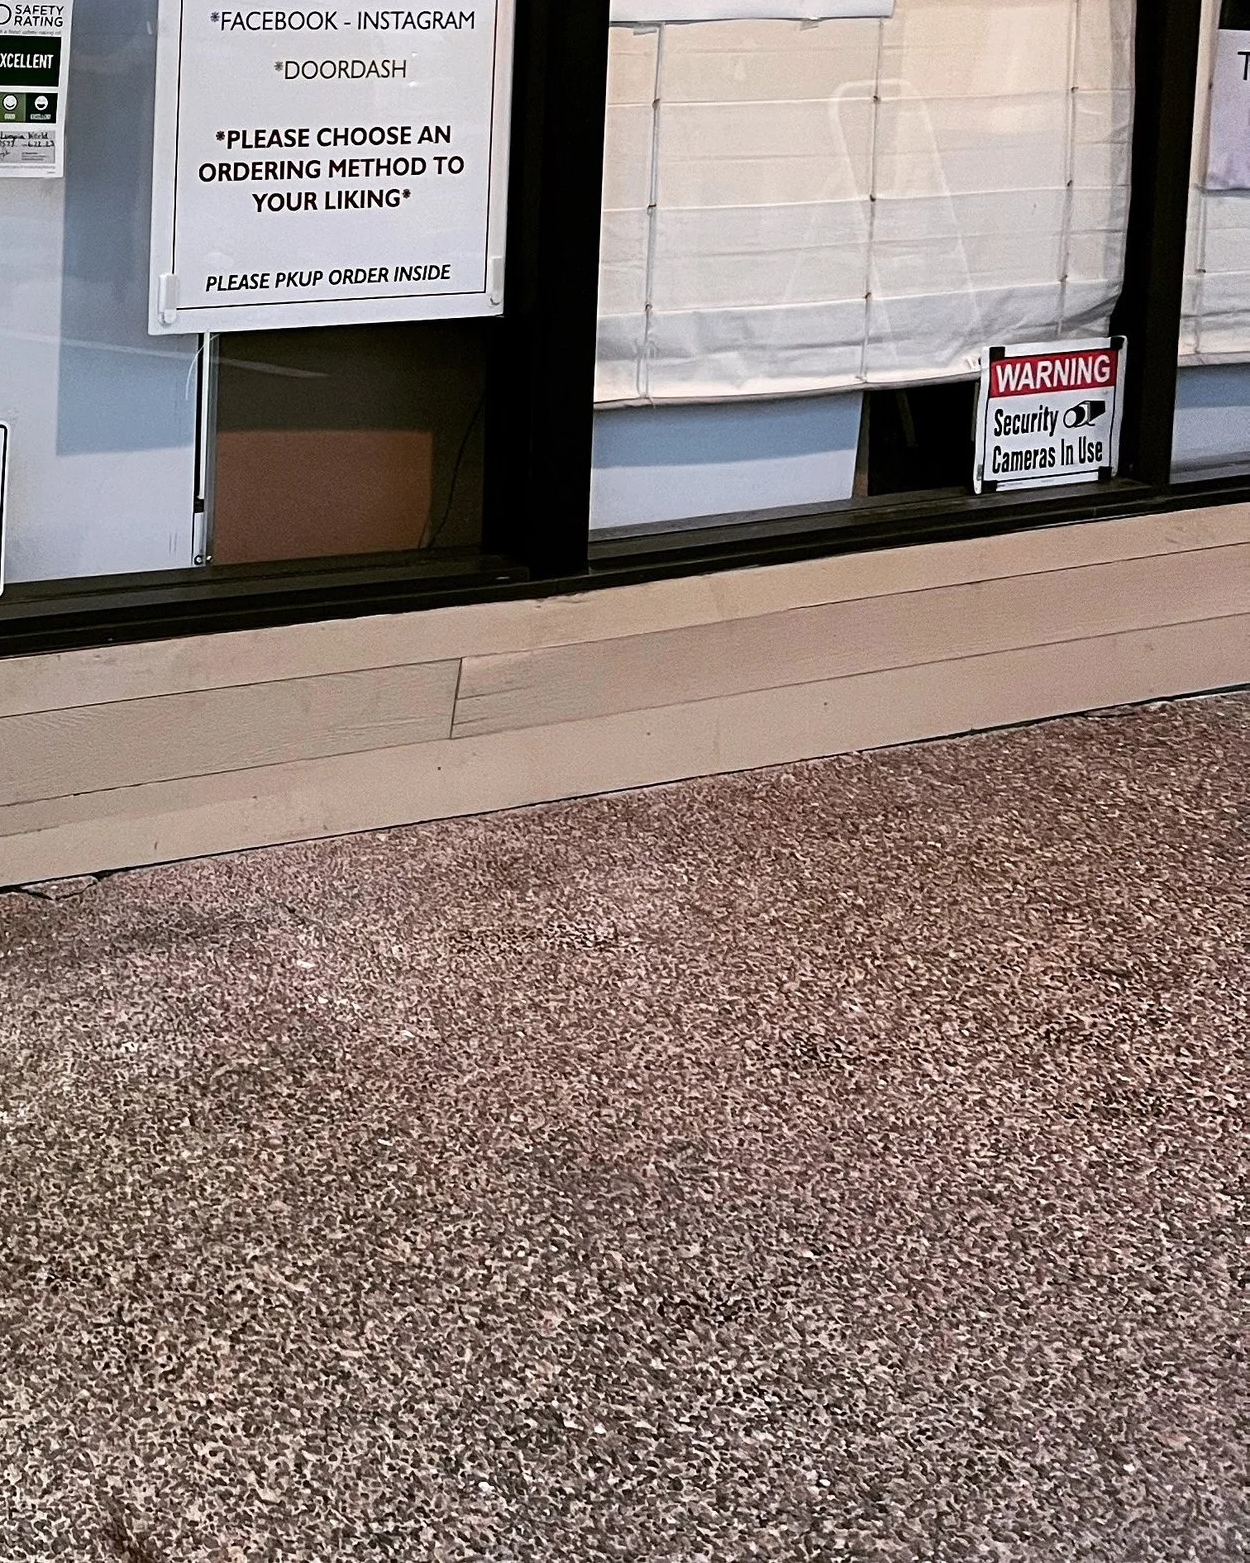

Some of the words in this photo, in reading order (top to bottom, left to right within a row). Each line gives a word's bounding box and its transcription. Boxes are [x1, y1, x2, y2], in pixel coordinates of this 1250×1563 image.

[14, 16, 64, 27] RATING
[15, 5, 64, 15] SAFETY
[357, 10, 475, 30] INSTAGRAM
[317, 126, 412, 148] CHOOSE
[417, 125, 451, 144] AN
[198, 161, 321, 183] ORDERING
[328, 157, 427, 179] METHOD
[432, 155, 465, 176] TO
[252, 191, 319, 213] YOUR
[205, 272, 271, 292] PLEASE
[275, 269, 324, 290] PKUP
[328, 267, 390, 287] ORDER
[394, 264, 452, 284] INSIDE
[996, 354, 1111, 393] WARNING
[994, 405, 1059, 437] Security
[992, 445, 1056, 475] Cameras
[1060, 440, 1075, 466] In
[1078, 436, 1104, 464] Use
